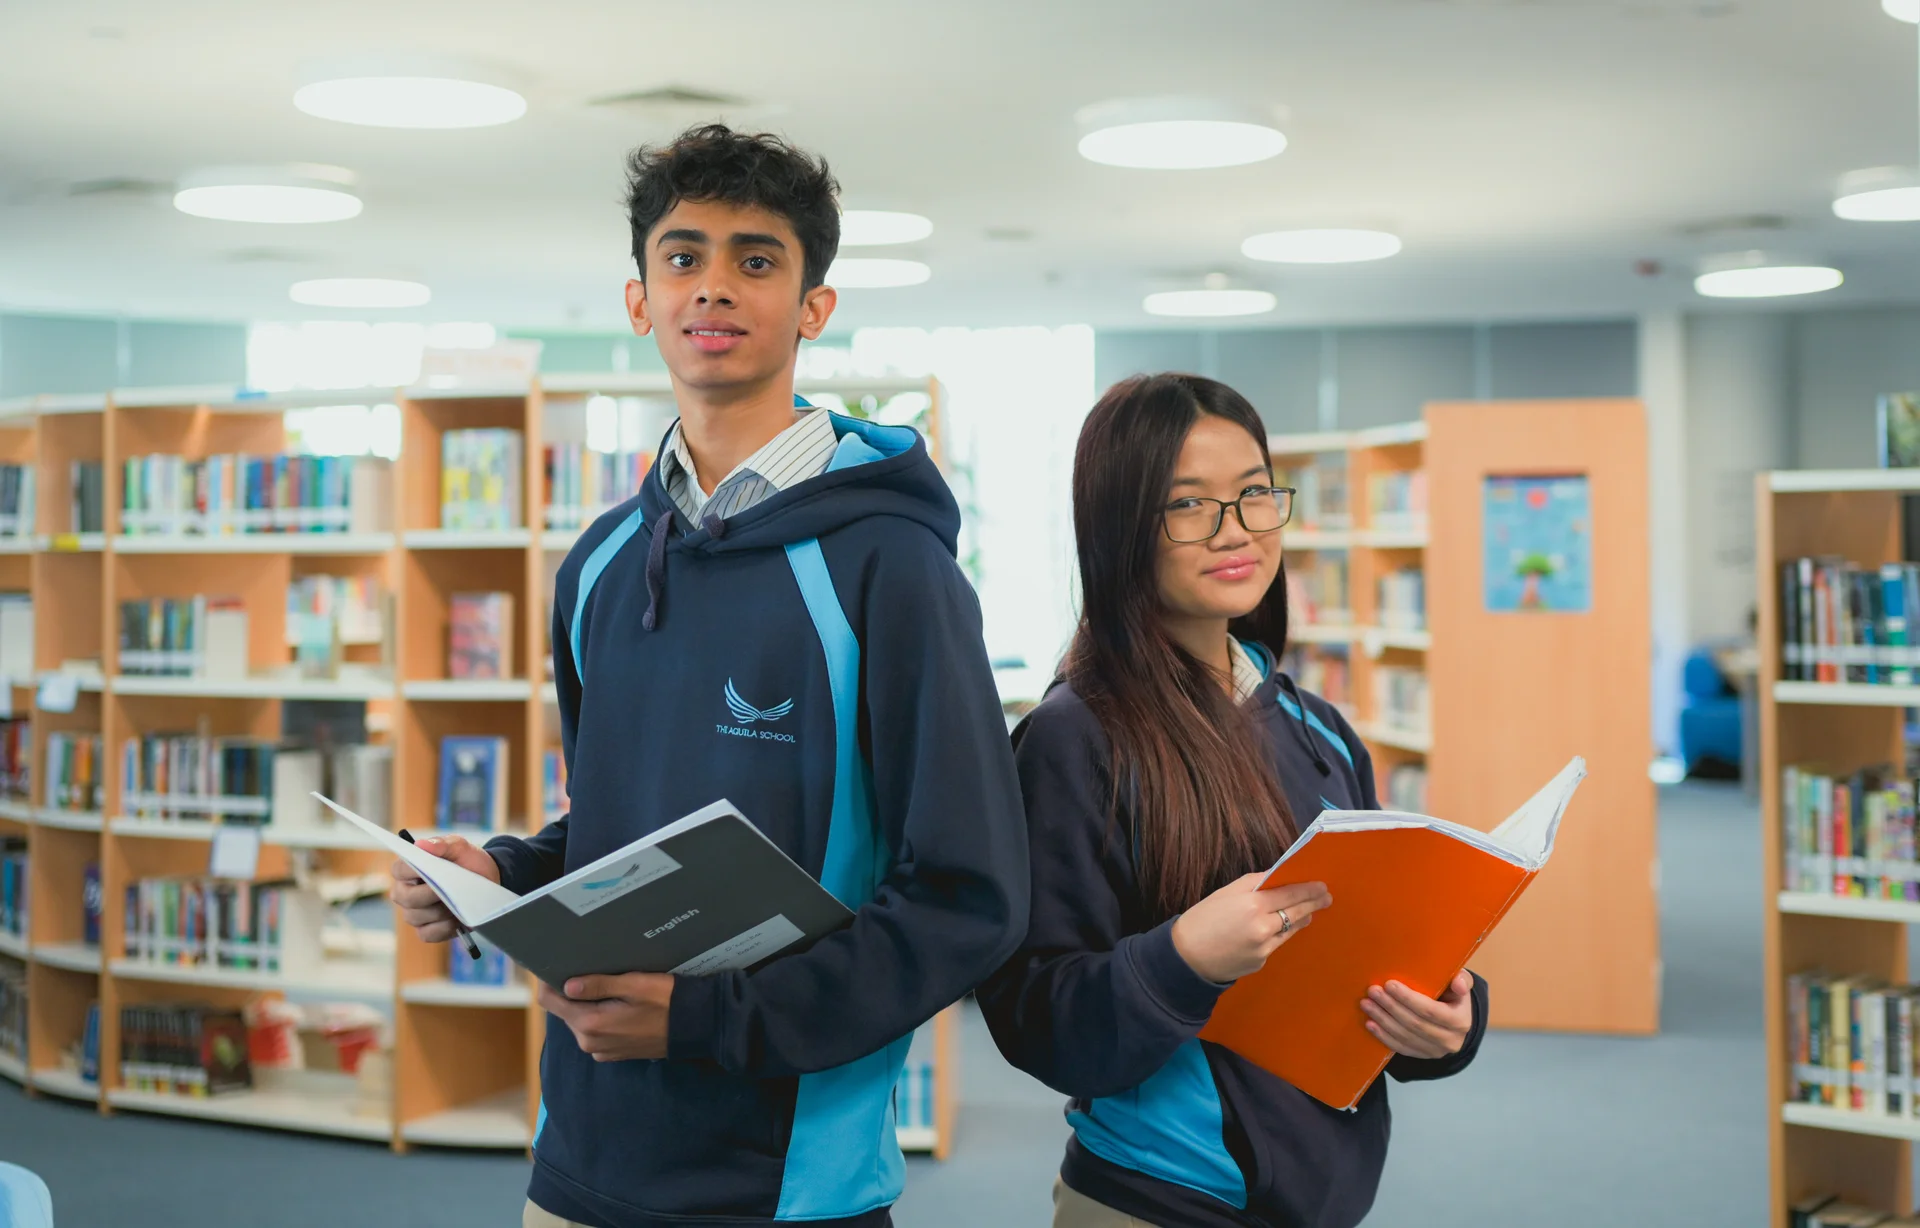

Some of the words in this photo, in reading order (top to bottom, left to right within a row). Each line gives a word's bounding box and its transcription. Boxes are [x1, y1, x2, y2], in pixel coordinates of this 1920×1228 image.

[728, 727, 757, 738] AQUILA
[760, 731, 796, 743] SCHOOL
[643, 908, 700, 939] English
